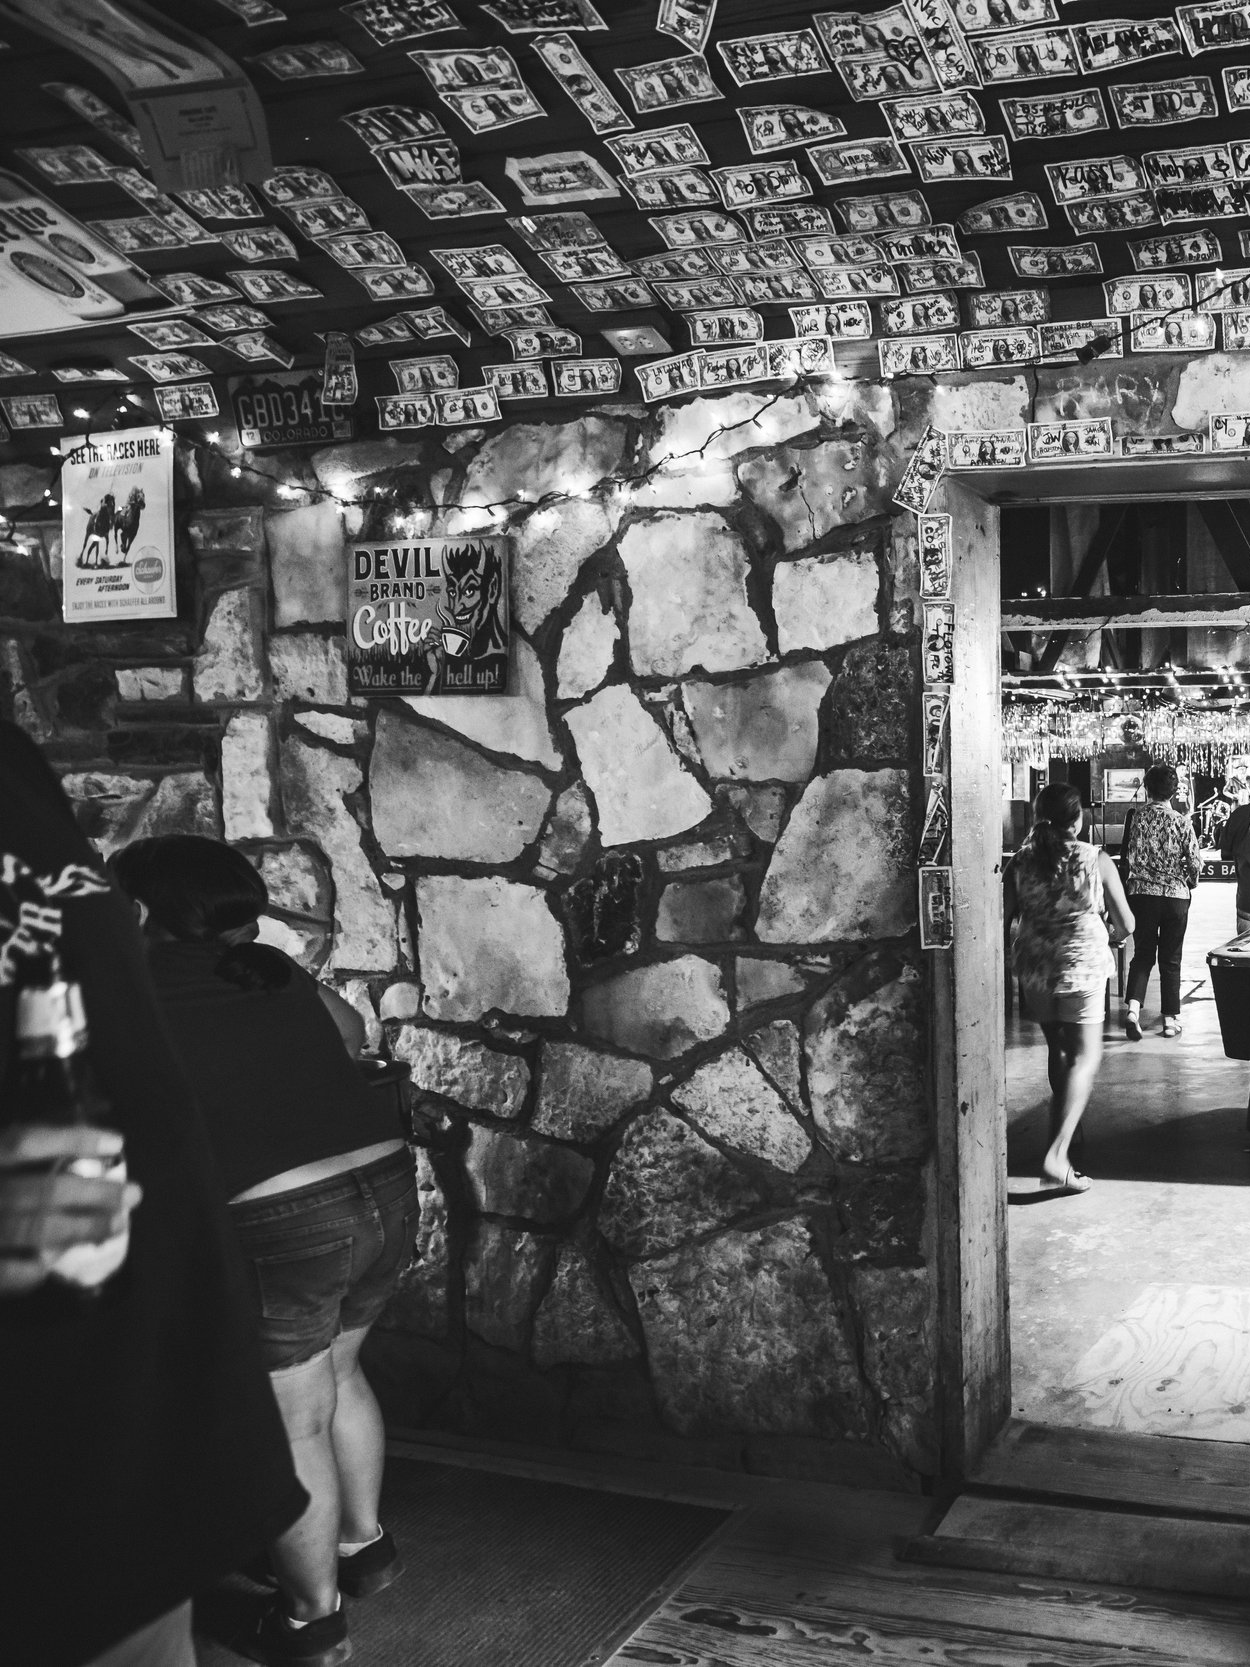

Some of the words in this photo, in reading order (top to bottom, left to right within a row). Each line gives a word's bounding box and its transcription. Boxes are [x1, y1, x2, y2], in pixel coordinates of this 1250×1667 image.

[71, 448, 86, 465] SEE
[107, 440, 135, 461] RACES
[137, 438, 160, 458] HERE
[354, 547, 441, 581] DEVIL
[369, 581, 427, 602] BRAND
[353, 602, 433, 656] Coffee
[353, 664, 397, 687] Wake
[400, 665, 422, 687] the
[446, 663, 472, 685] hell
[476, 663, 500, 690] up!
